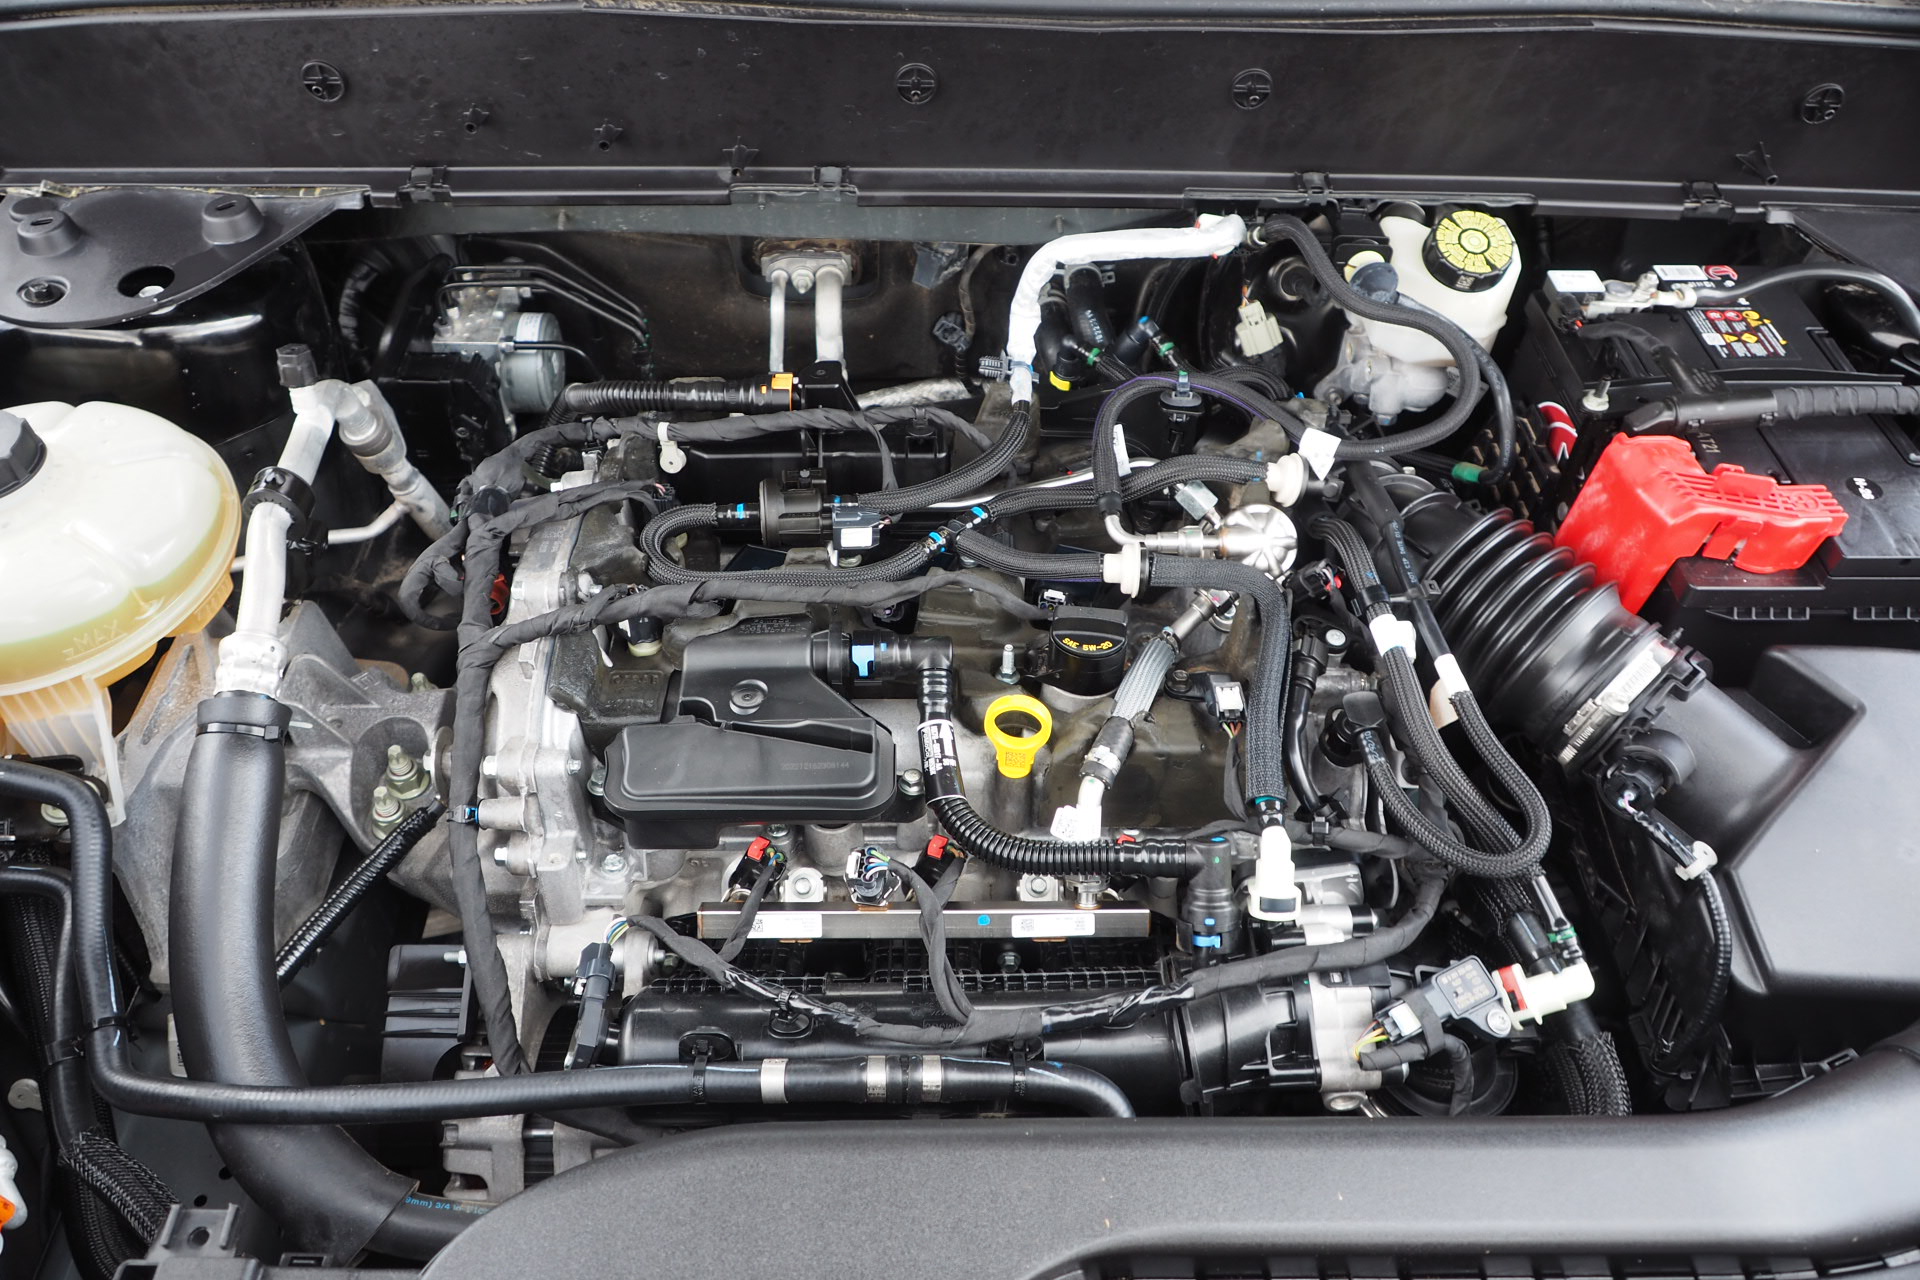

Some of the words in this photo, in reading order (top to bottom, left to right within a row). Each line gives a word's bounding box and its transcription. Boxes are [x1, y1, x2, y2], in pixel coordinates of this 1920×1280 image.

[73, 619, 123, 653] MAX
[1062, 637, 1080, 649] SAE
[1083, 640, 1113, 652] 5W-20
[434, 1202, 451, 1210] 3/4
